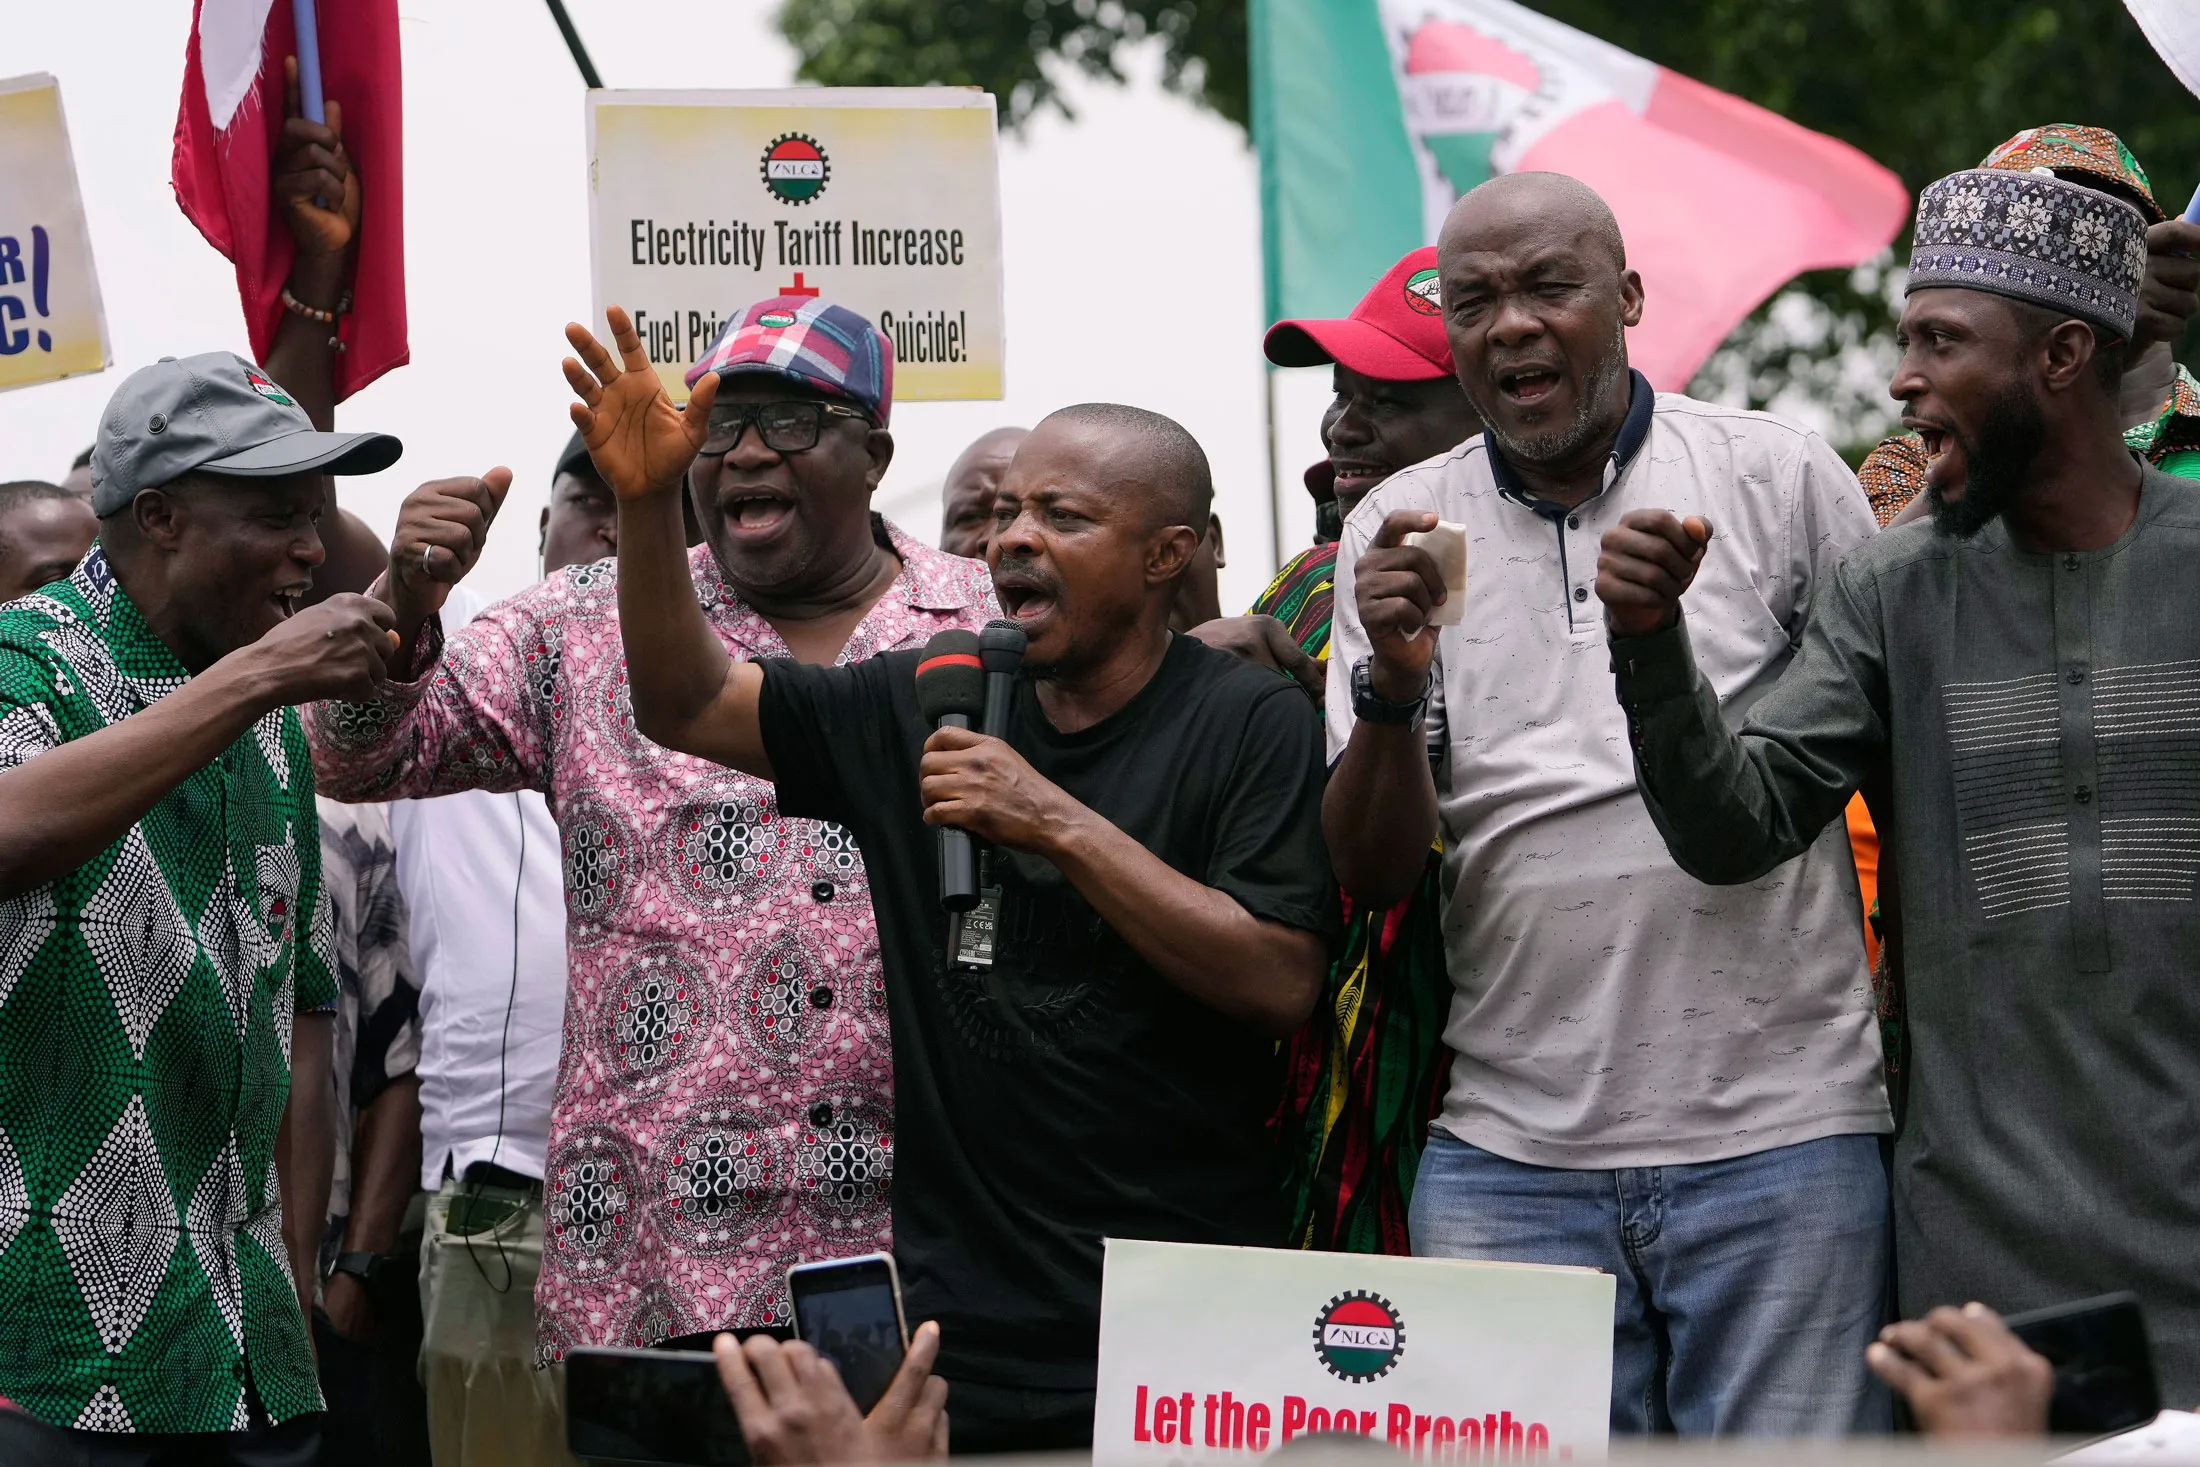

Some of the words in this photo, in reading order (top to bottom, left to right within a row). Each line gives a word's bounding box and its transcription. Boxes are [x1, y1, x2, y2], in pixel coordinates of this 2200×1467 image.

[782, 164, 810, 175] NLC
[631, 219, 765, 271] Electricity
[774, 220, 841, 265] Tariff
[852, 220, 964, 266] Increase
[688, 310, 727, 363] Pri
[881, 310, 968, 363] Suicide!
[1341, 1329, 1379, 1345] NLC
[1134, 1385, 1194, 1445] Let
[1204, 1391, 1271, 1453] the
